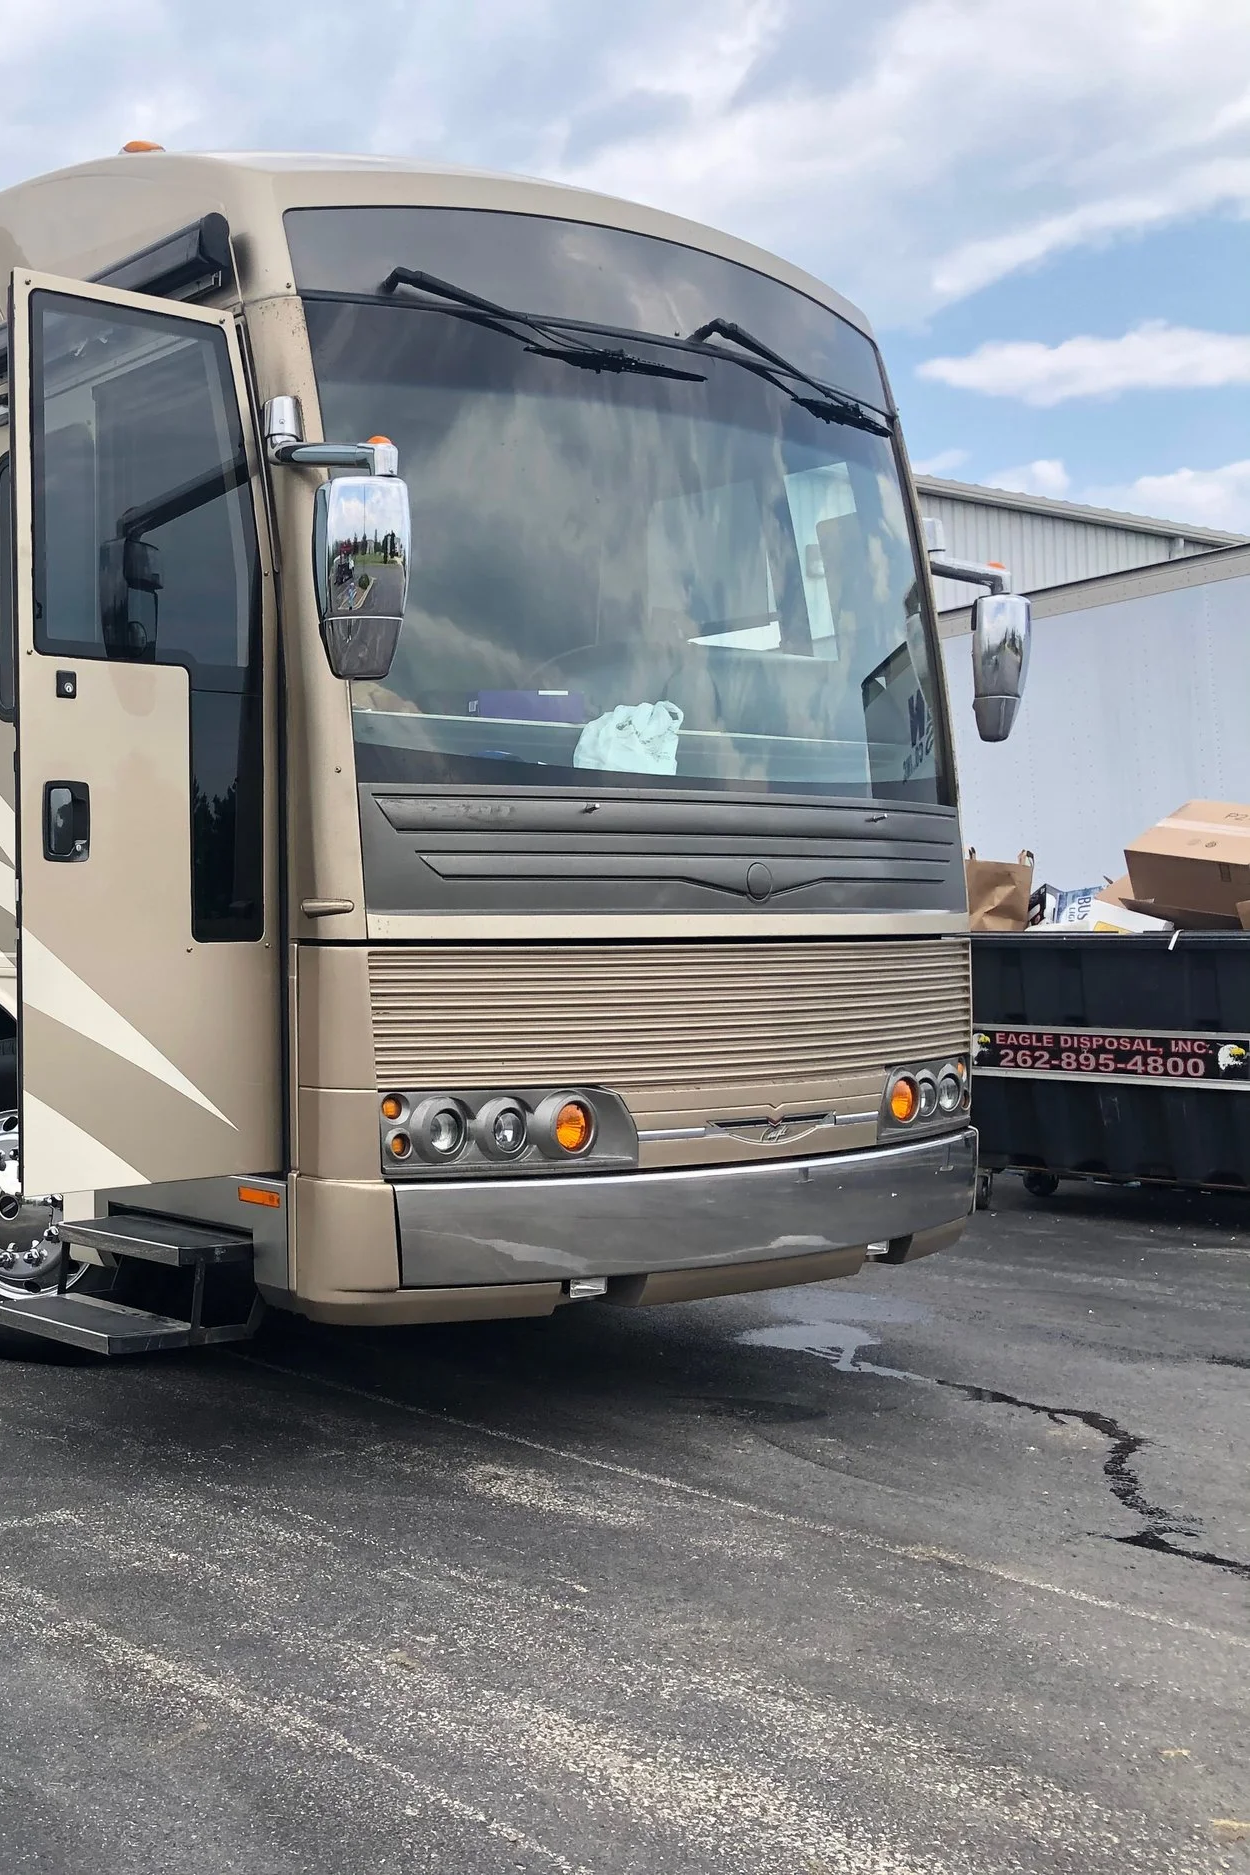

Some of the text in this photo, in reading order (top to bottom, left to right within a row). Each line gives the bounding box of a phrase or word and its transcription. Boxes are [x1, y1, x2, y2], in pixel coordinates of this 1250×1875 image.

[1068, 907, 1076, 922] LIG
[1077, 896, 1092, 920] BUS
[995, 1032, 1054, 1047] EAGLE
[1171, 1040, 1213, 1054] INC.
[999, 1049, 1206, 1077] 262-895-4800
